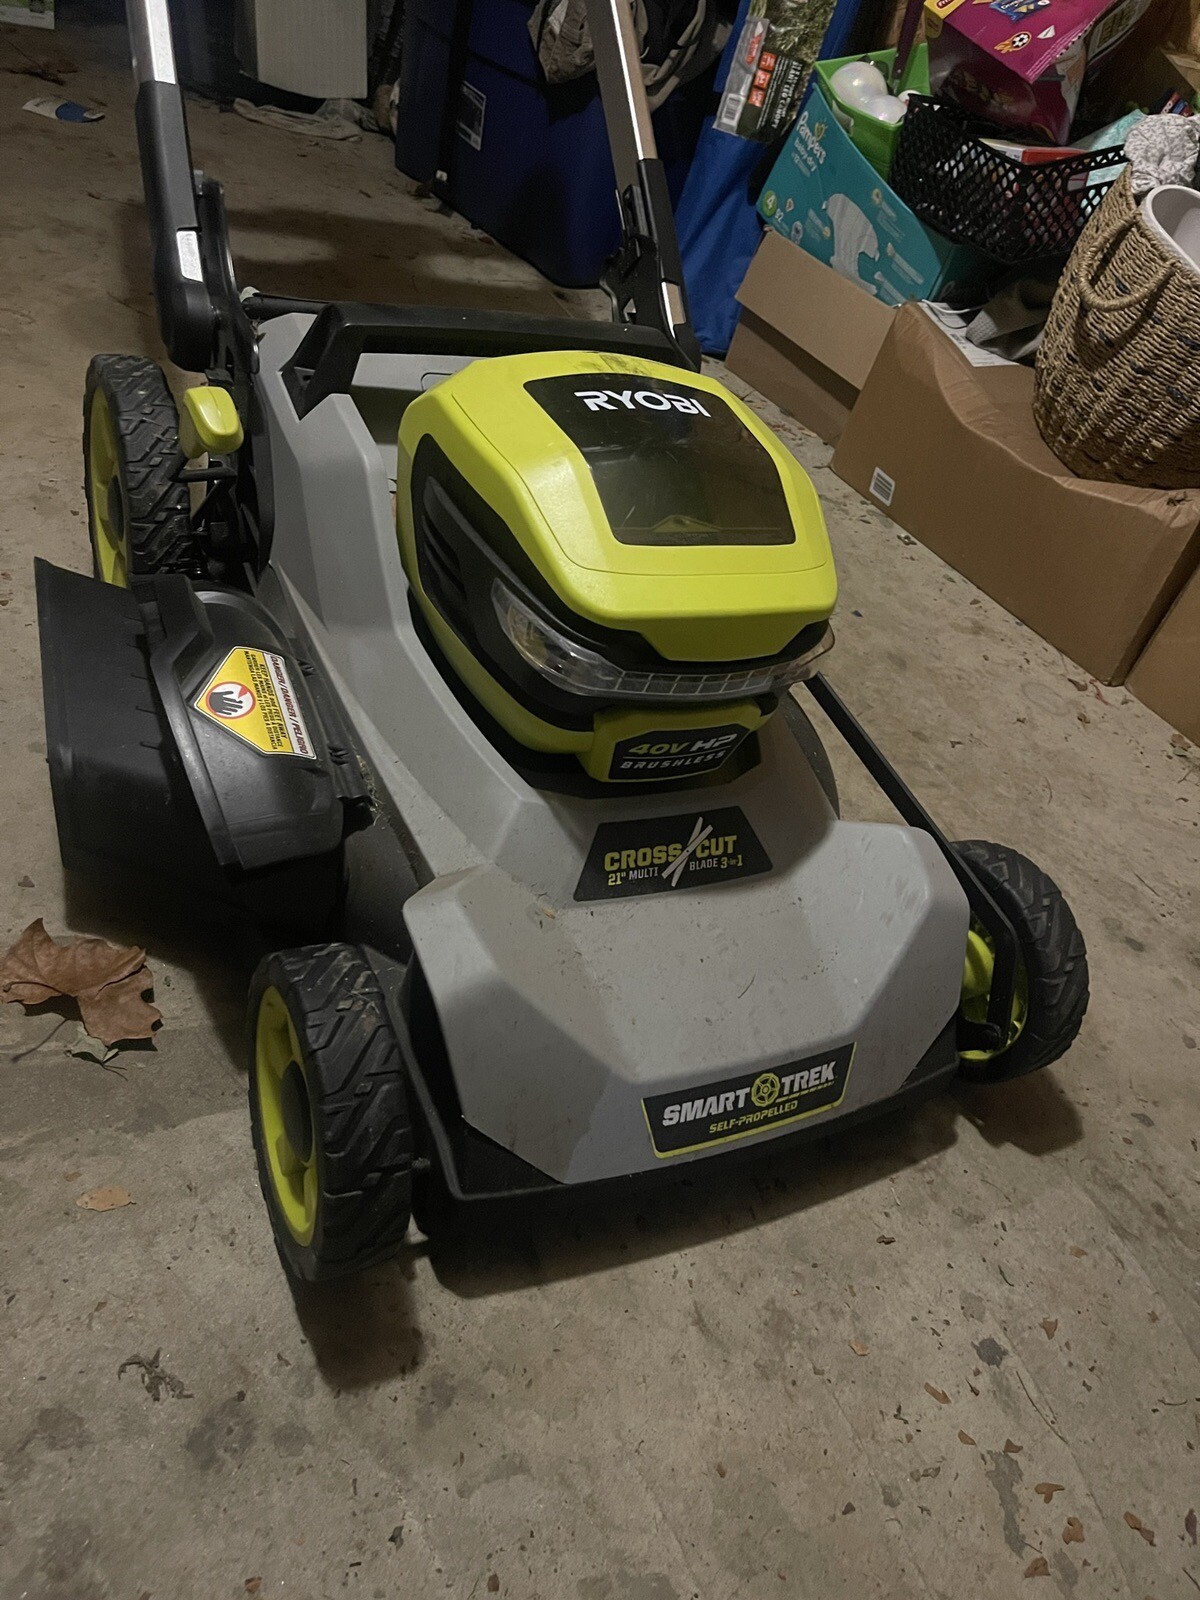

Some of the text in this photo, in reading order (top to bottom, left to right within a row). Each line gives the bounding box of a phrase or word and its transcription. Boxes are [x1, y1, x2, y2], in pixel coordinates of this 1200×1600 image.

[771, 99, 786, 128] CANOPY
[796, 111, 825, 164] Pampers
[574, 390, 711, 417] RYOBI
[244, 651, 255, 673] MANTENGA
[266, 727, 278, 750] DISTANCIA
[264, 678, 274, 696] HANDS
[277, 723, 287, 738] AWAY
[271, 656, 284, 683] DANGER
[281, 688, 296, 717] DANGER
[293, 724, 308, 754] PELIGRO
[273, 727, 283, 747] DISTANCE
[629, 733, 738, 755] 40V HP
[620, 750, 726, 769] BRUSHLESS
[604, 835, 737, 872] CROSS CUT
[608, 872, 626, 886] 21"
[628, 867, 659, 881] MULTI
[689, 857, 718, 871] BLADE
[662, 1061, 837, 1127] SMART TREK
[709, 1100, 798, 1134] SELF-PROPELLED
